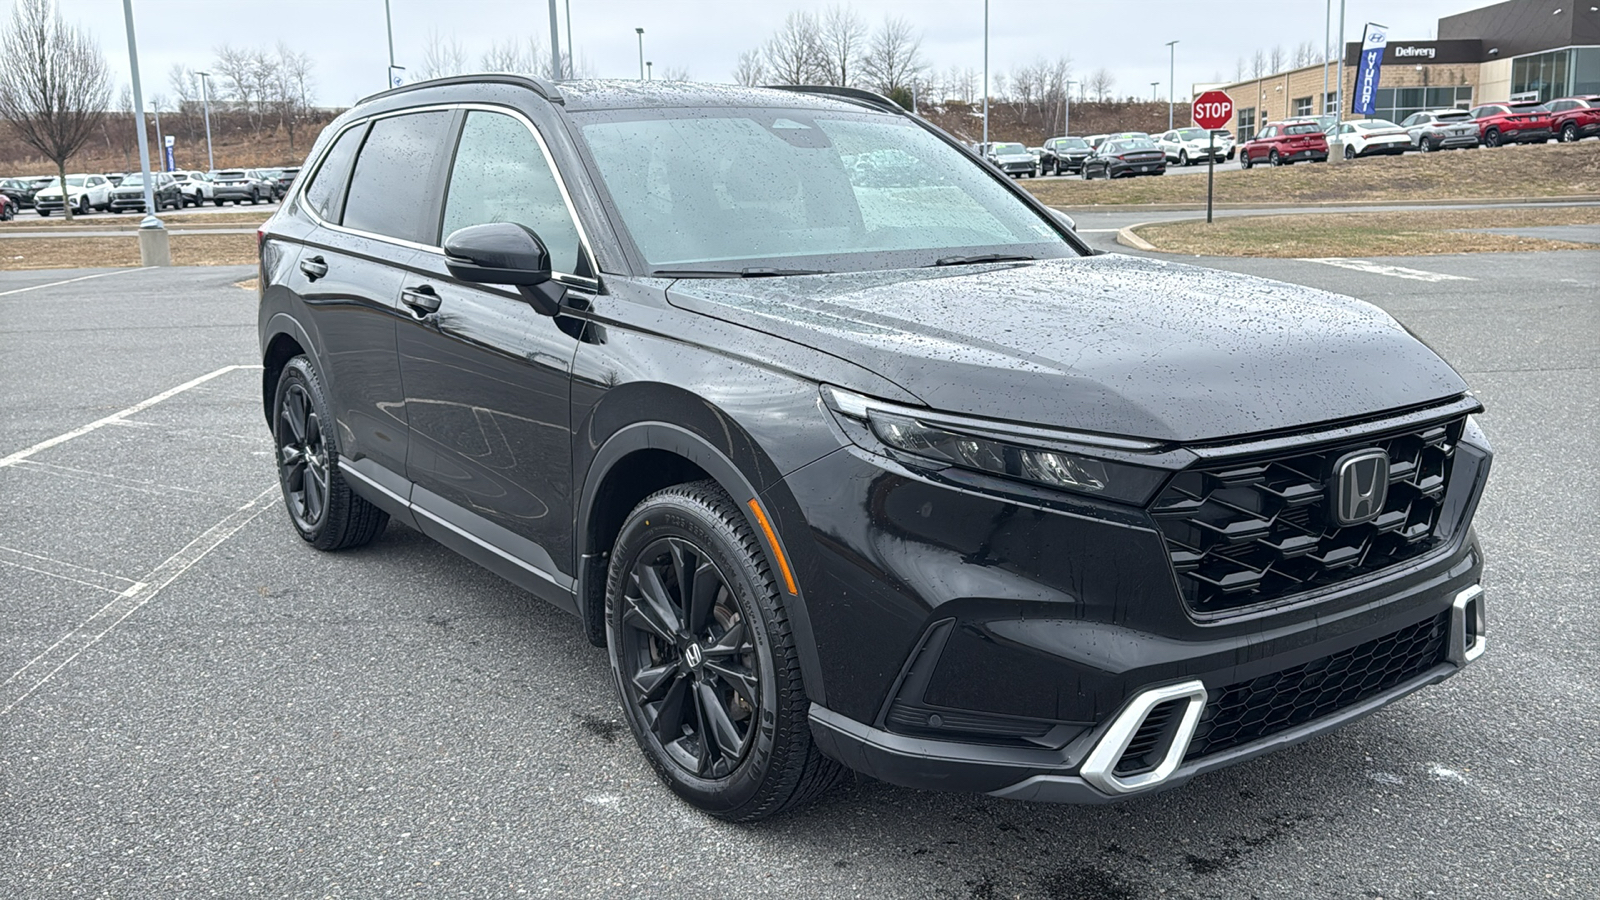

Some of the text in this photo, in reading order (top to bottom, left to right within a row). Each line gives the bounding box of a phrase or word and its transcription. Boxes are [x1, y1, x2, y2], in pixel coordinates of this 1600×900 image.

[1395, 46, 1435, 59] Delivery
[1361, 51, 1377, 112] HYUNDAI
[1195, 102, 1231, 119] STOP
